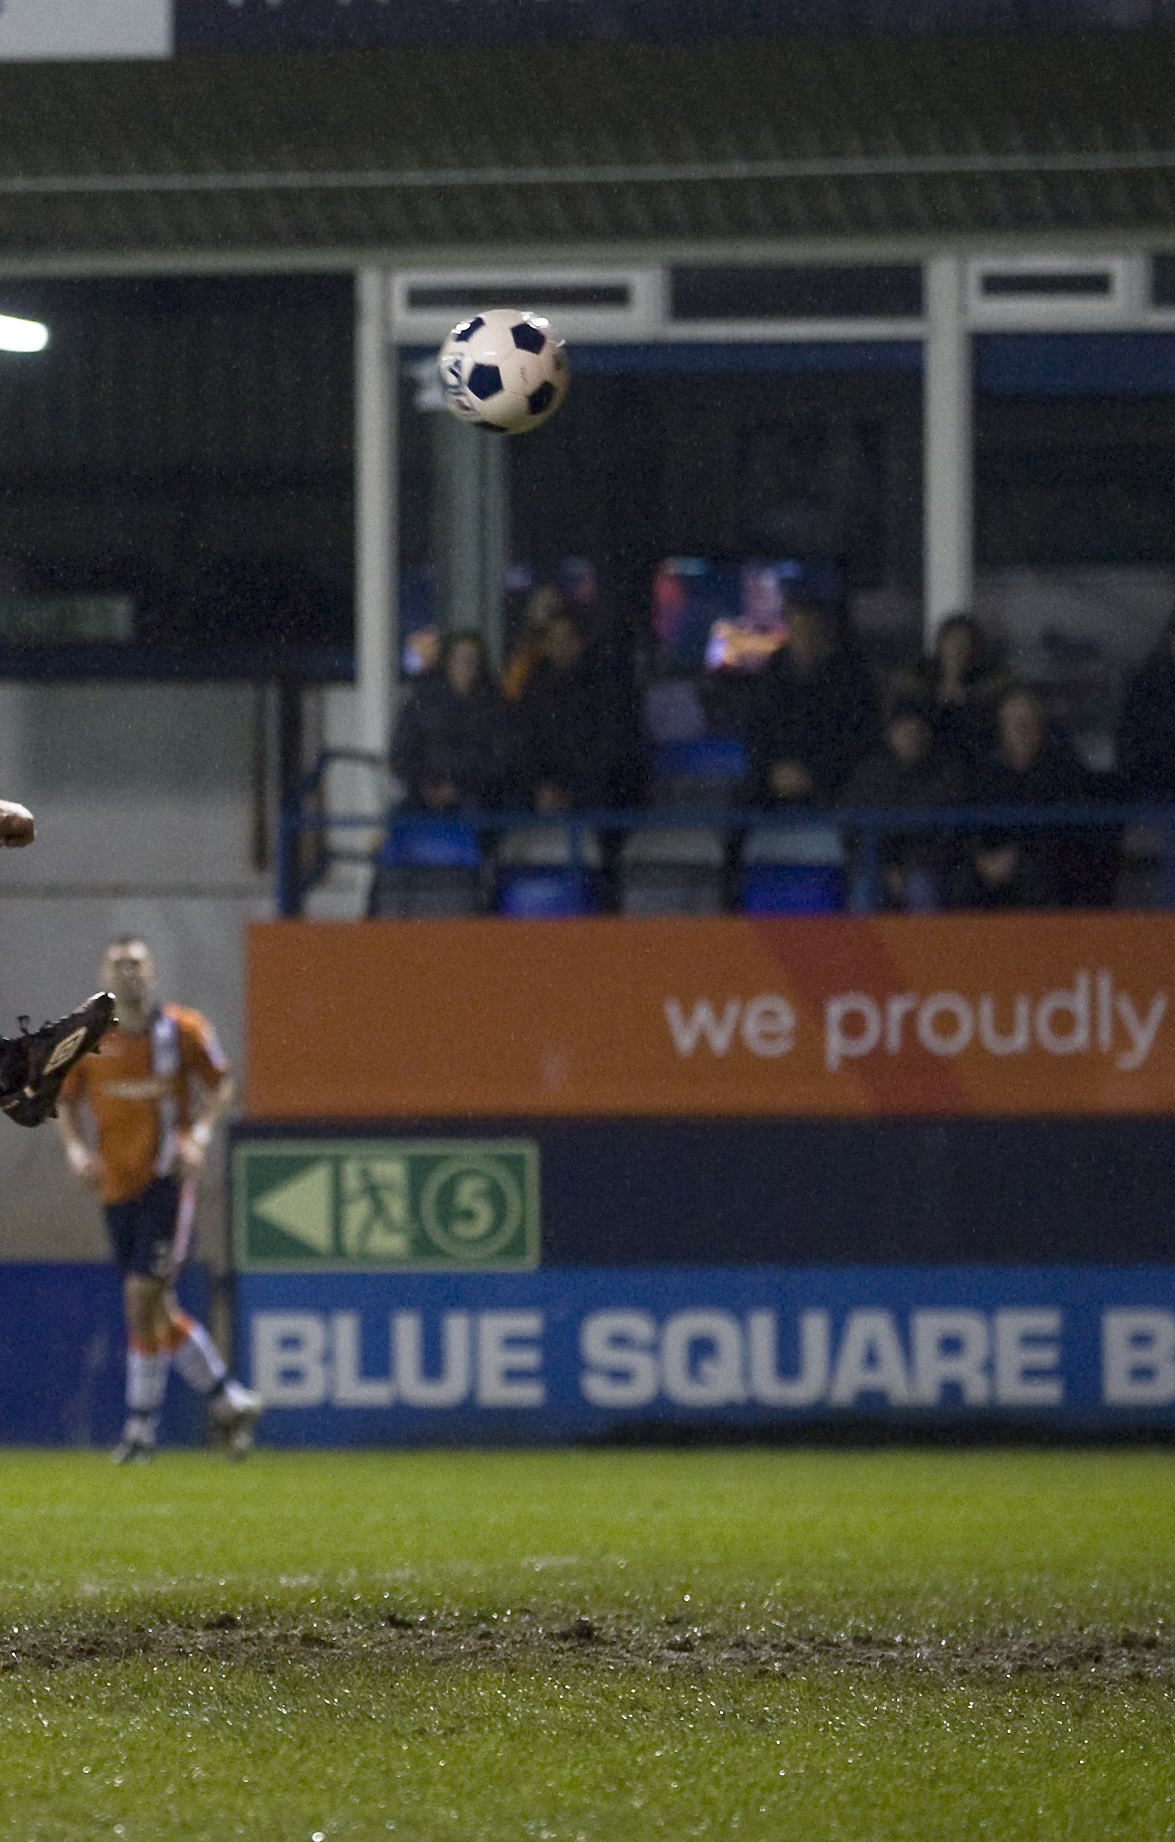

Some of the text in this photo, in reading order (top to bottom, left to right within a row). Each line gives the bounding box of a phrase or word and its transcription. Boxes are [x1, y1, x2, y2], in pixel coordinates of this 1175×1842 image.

[664, 968, 1167, 1071] we proudly
[447, 1176, 495, 1240] 5
[252, 1310, 544, 1408] BLUE
[579, 1308, 1062, 1408] SQUARE
